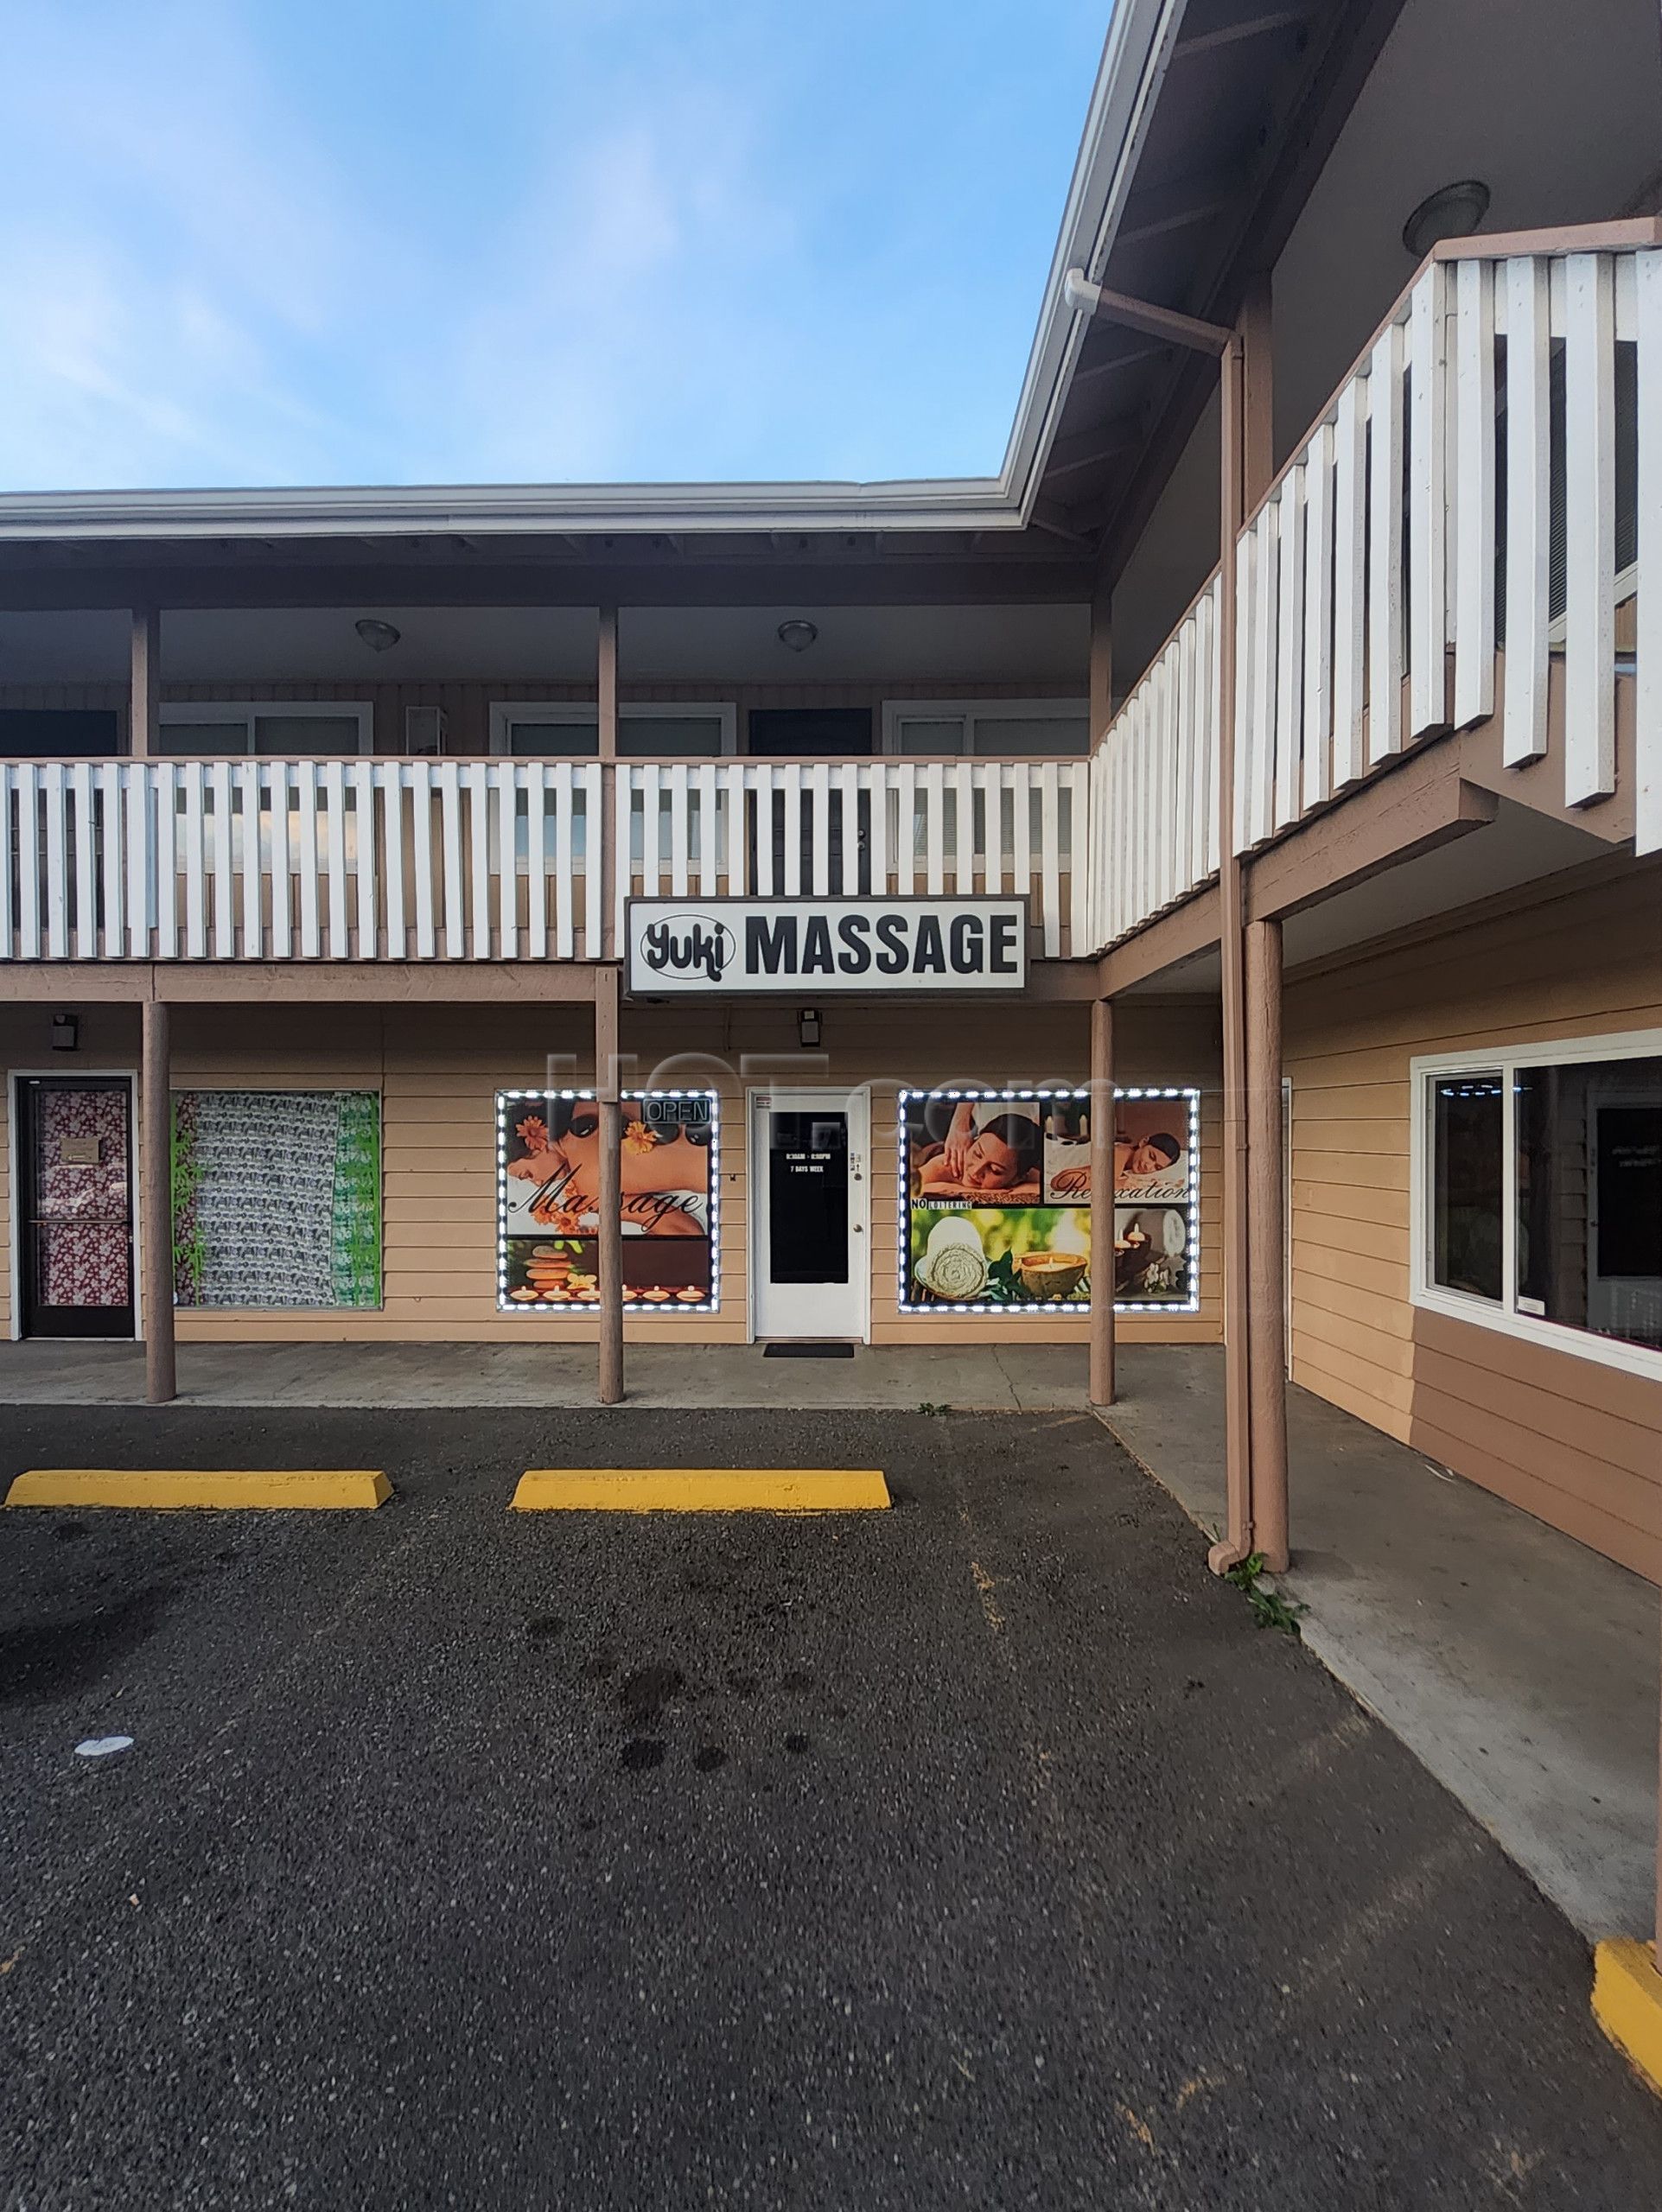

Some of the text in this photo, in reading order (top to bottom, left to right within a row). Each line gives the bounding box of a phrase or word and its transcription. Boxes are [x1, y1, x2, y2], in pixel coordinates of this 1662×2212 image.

[745, 914, 1017, 975] MASSAGE
[647, 1102, 707, 1121] OPEN
[1049, 1171, 1191, 1199] Rexation
[912, 1198, 971, 1210] NO LOITERING
